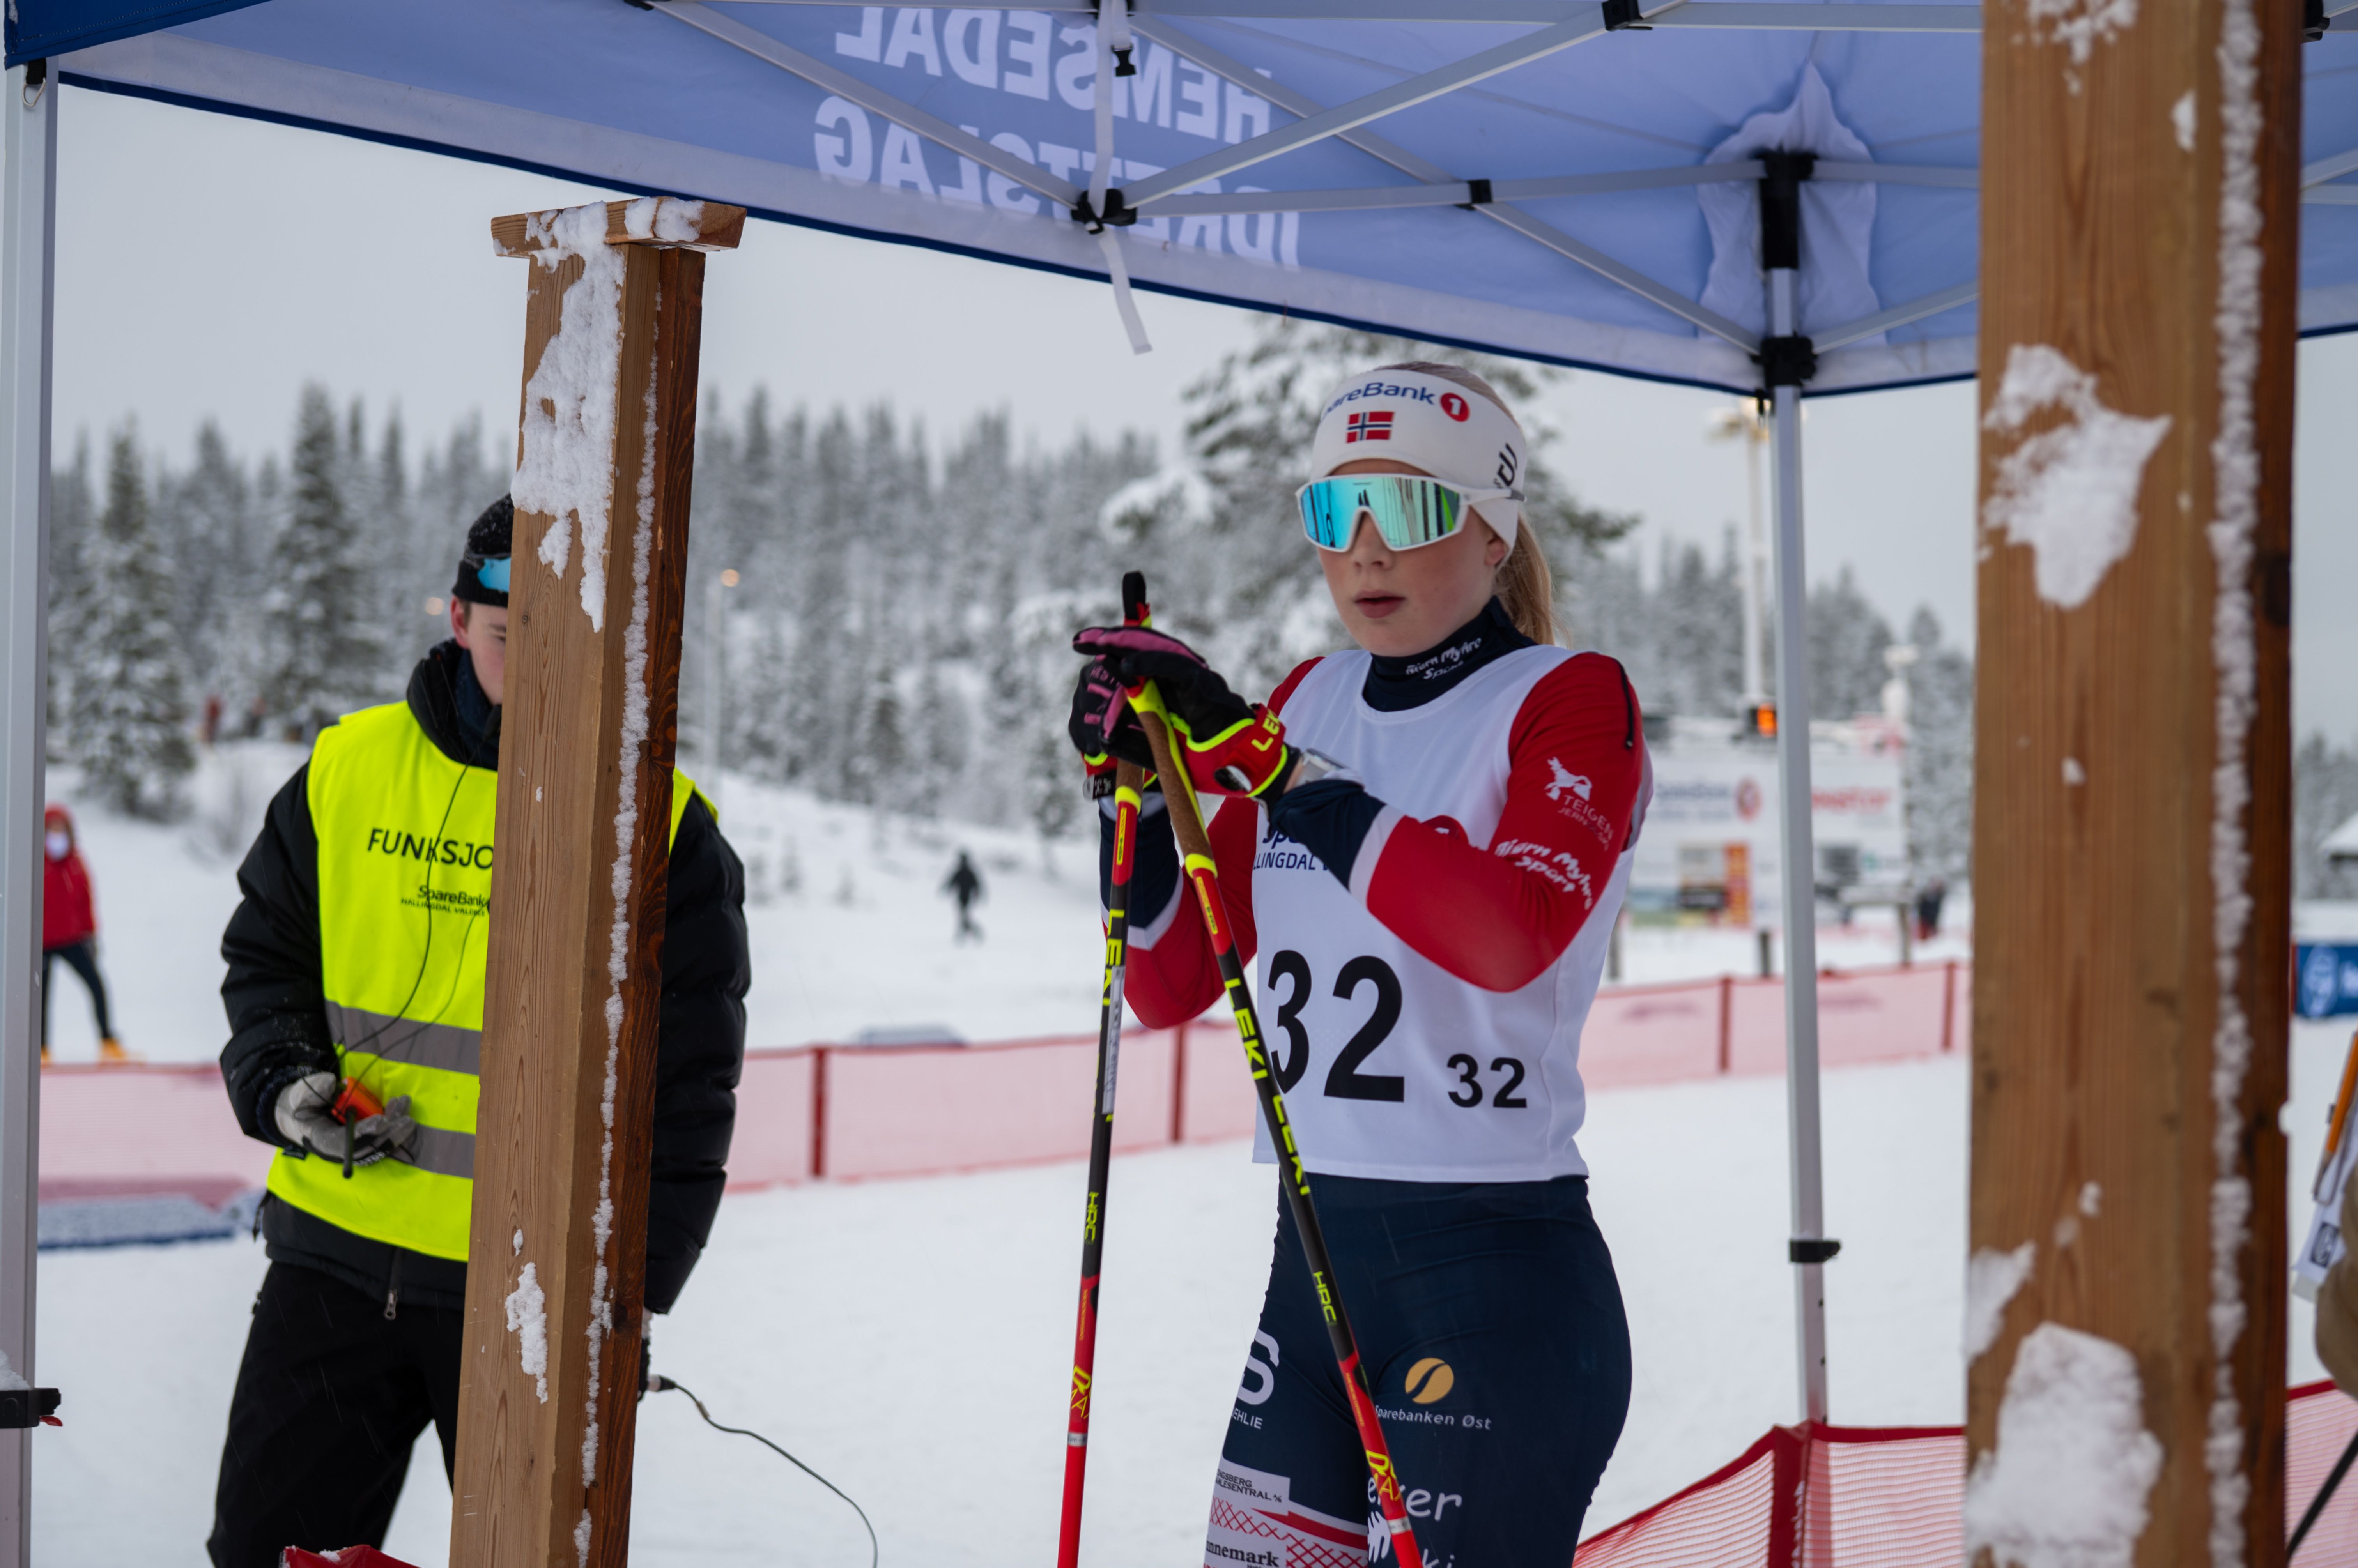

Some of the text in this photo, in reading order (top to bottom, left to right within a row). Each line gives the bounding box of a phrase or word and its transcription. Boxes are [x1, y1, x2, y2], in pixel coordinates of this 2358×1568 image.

[1564, 794, 1614, 840] TEIGEN
[418, 884, 486, 907] SpareBank
[1225, 977, 1268, 1080] LEKI
[1268, 949, 1404, 1103] 32
[1447, 1053, 1527, 1108] 32
[1085, 1191, 1099, 1241] HRC
[1312, 1271, 1337, 1323] HRC
[1232, 1407, 1263, 1430] EHLIE
[1462, 1414, 1492, 1430] Øst
